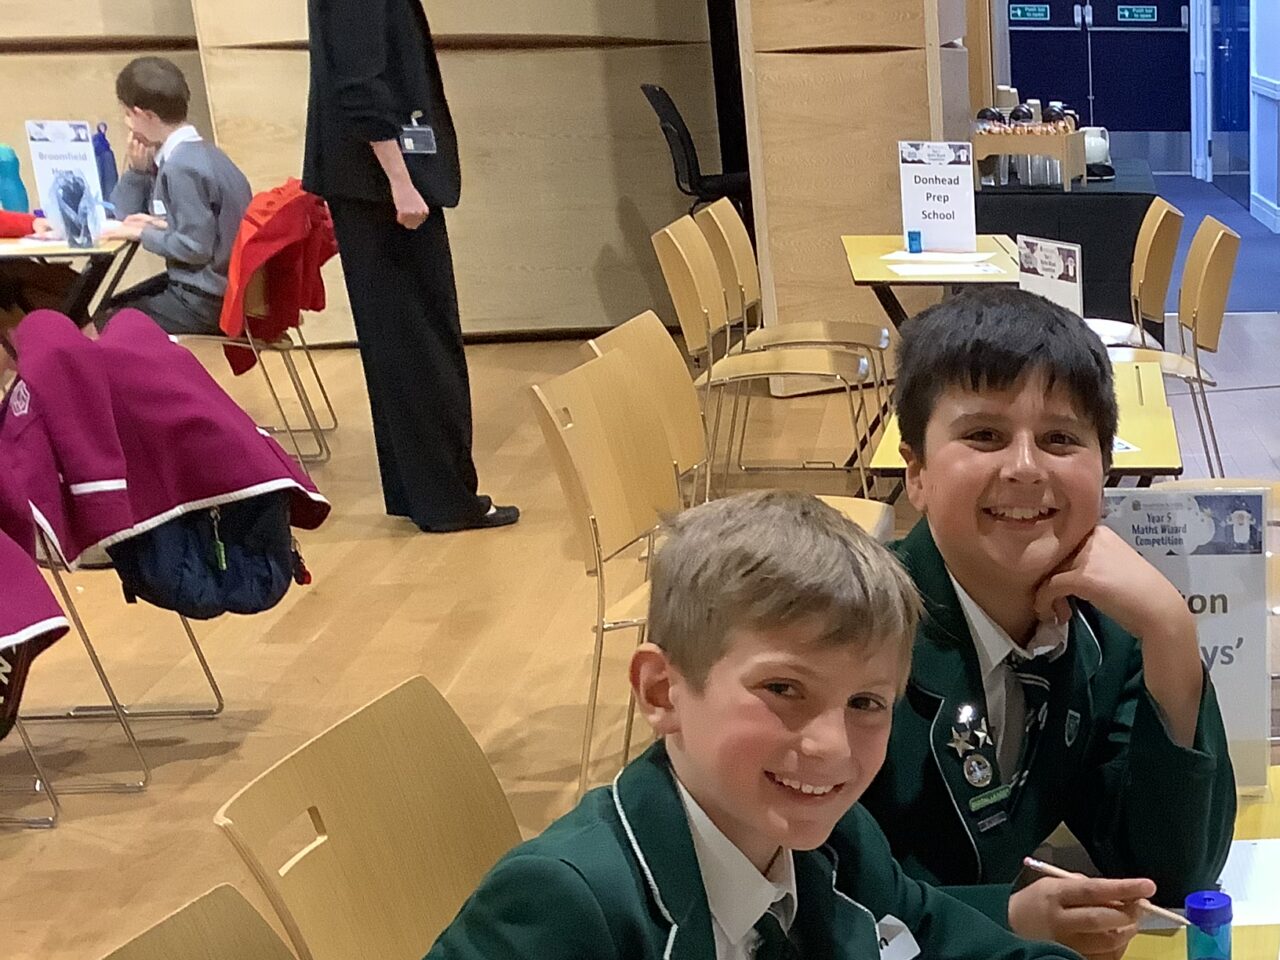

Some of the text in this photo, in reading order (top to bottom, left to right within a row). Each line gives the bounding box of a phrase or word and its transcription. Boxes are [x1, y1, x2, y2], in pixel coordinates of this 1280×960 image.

[914, 174, 960, 186] Donhead
[926, 192, 950, 204] Prep
[921, 209, 955, 221] School
[1146, 512, 1164, 524] Year
[1131, 523, 1187, 535] Maths Wizard
[1135, 535, 1184, 547] Competition
